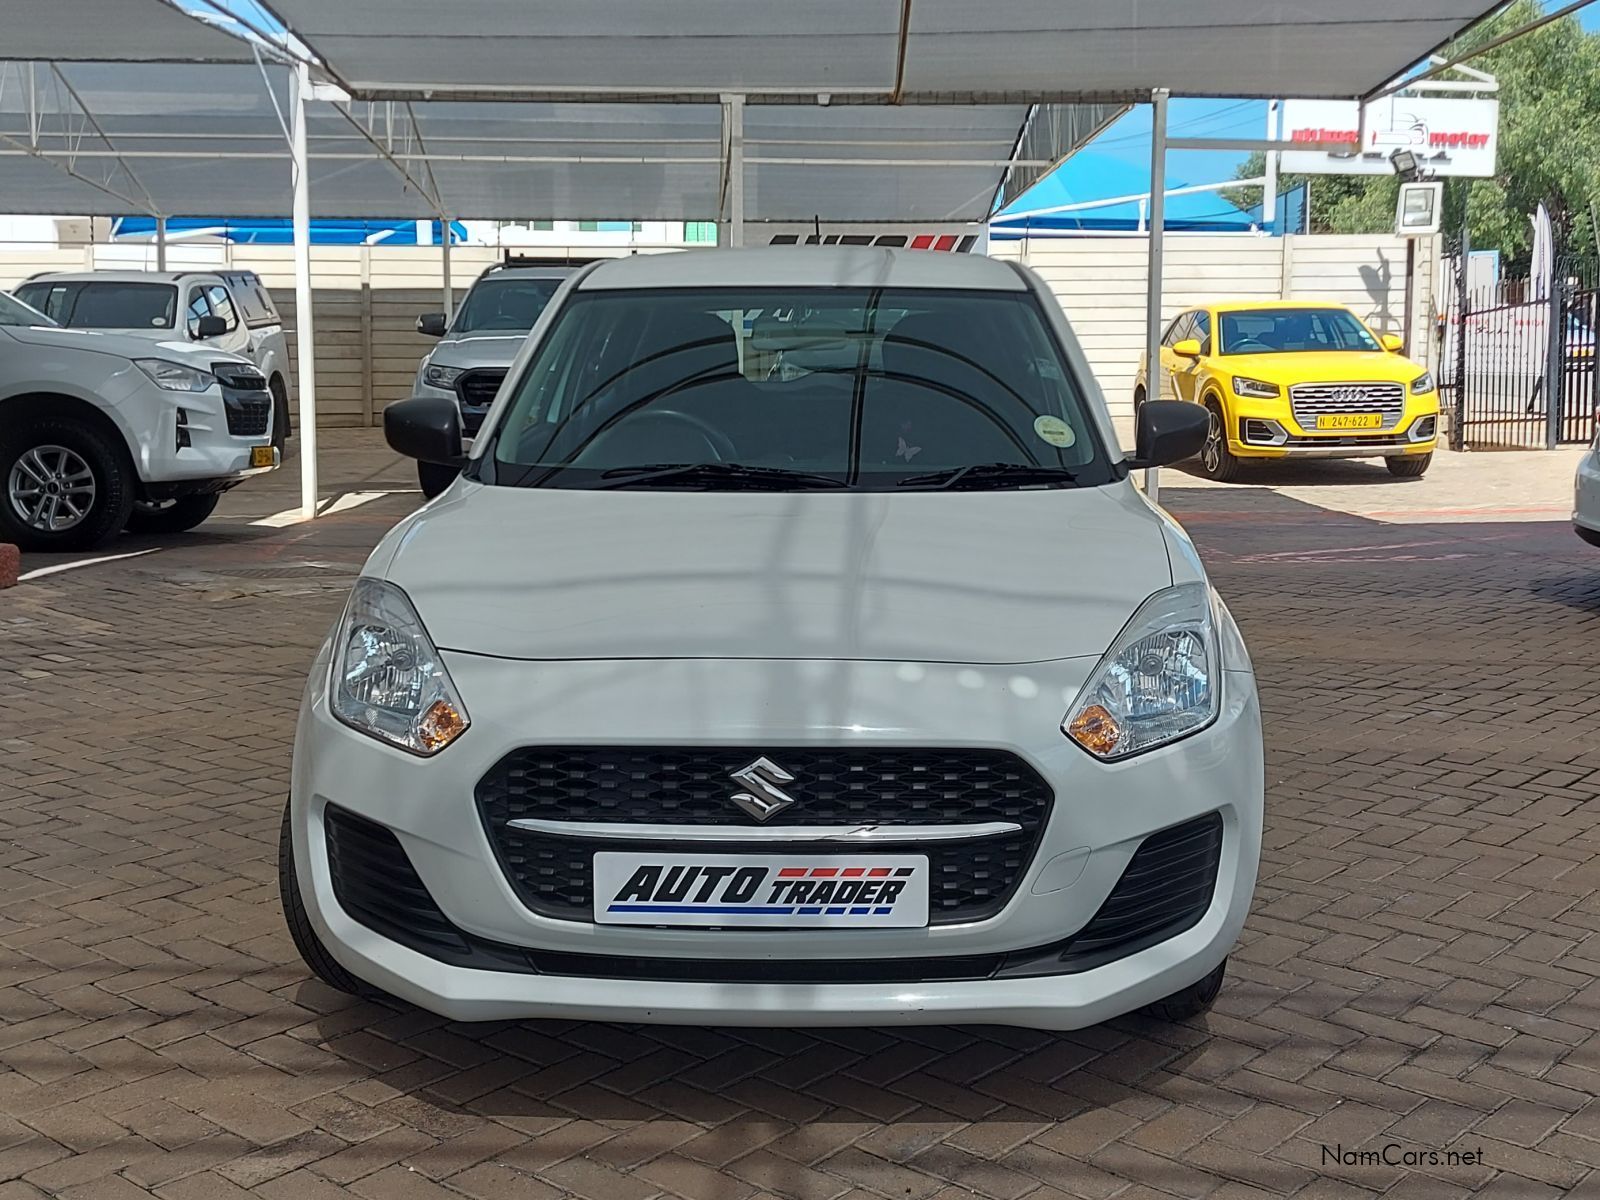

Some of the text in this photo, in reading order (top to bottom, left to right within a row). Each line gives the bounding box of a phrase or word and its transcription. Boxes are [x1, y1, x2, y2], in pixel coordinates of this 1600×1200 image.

[1429, 132, 1490, 146] motor
[1319, 416, 1380, 427] N 247-622 W
[613, 865, 908, 905] AUTO TRADER
